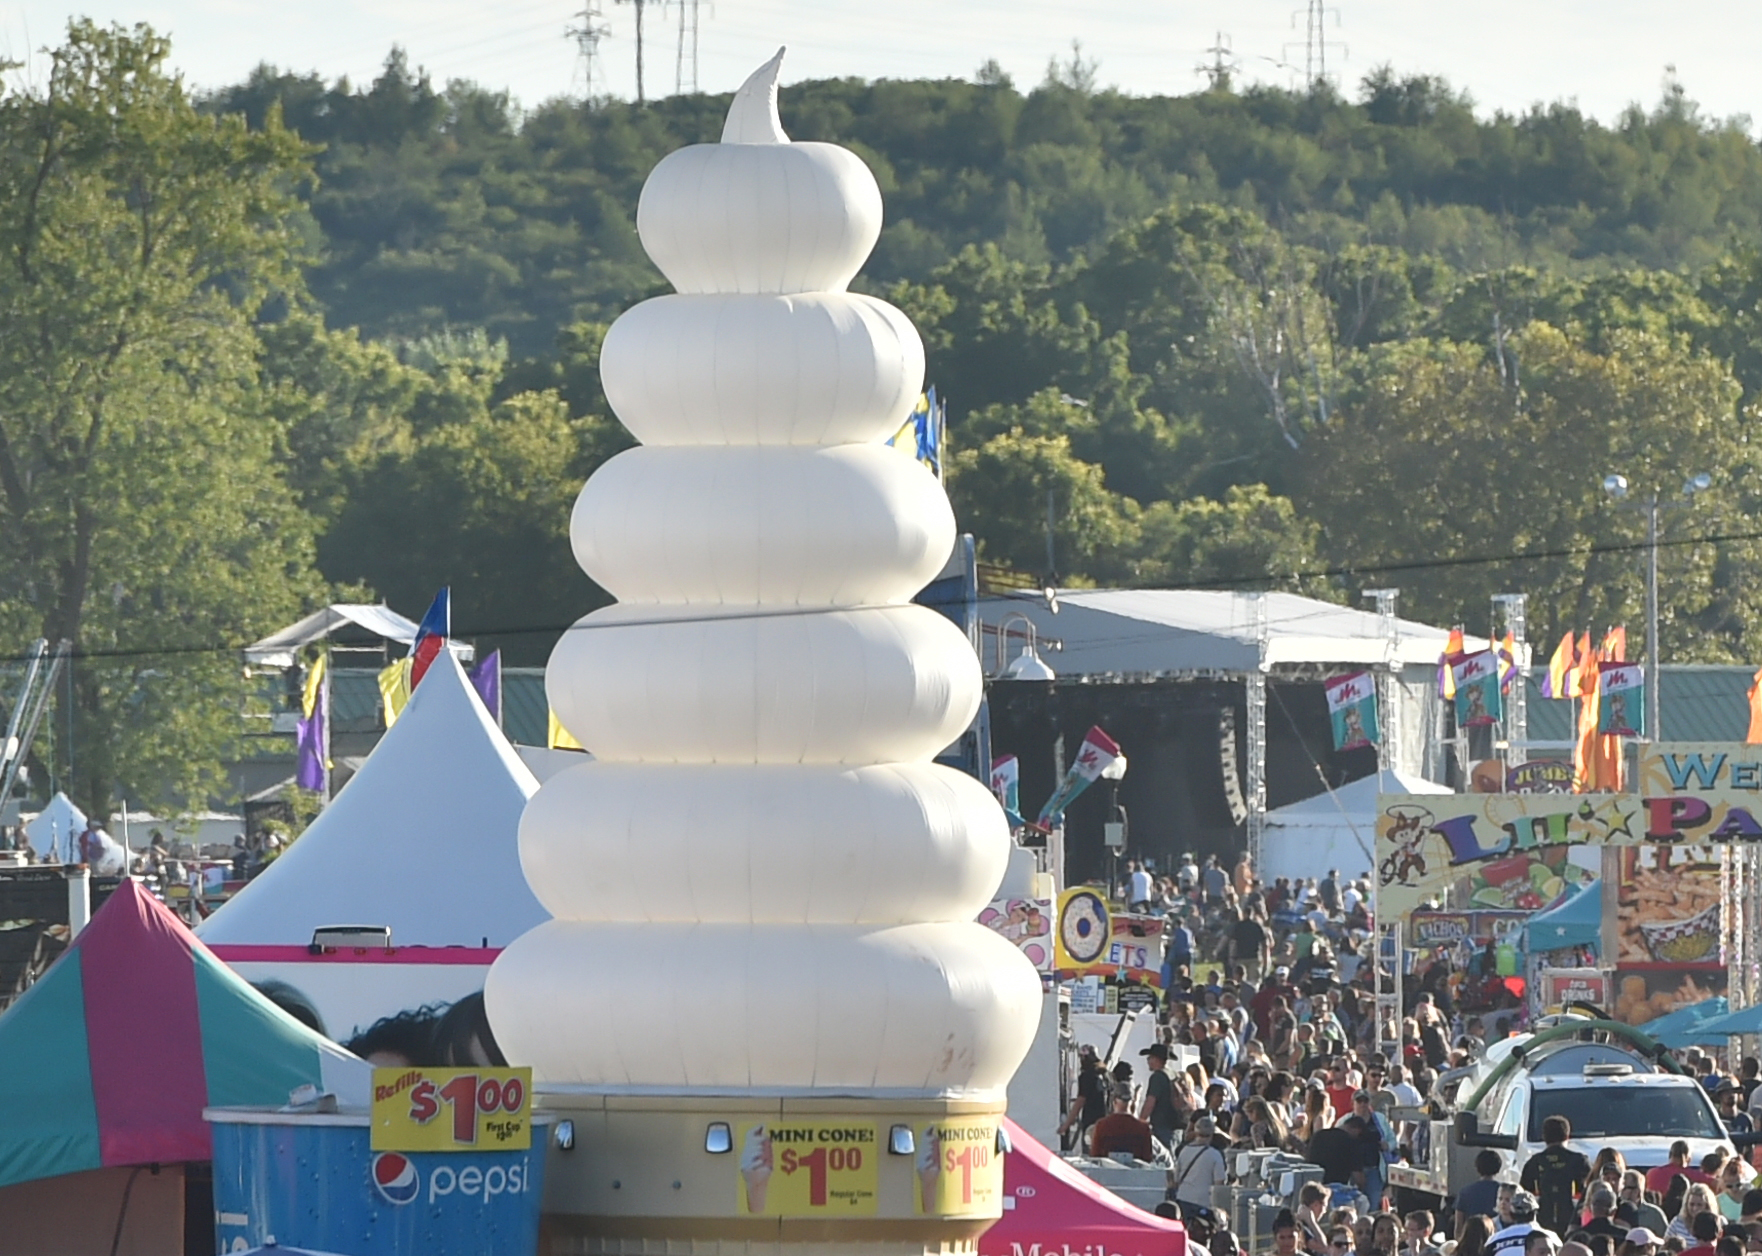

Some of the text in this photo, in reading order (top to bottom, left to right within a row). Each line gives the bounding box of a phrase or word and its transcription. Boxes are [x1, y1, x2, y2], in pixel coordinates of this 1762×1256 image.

[375, 1070, 423, 1102] Refills
[769, 1128, 874, 1143] MINI CONE!
[937, 1126, 966, 1140] MINI
[429, 1156, 529, 1204] pepsi
